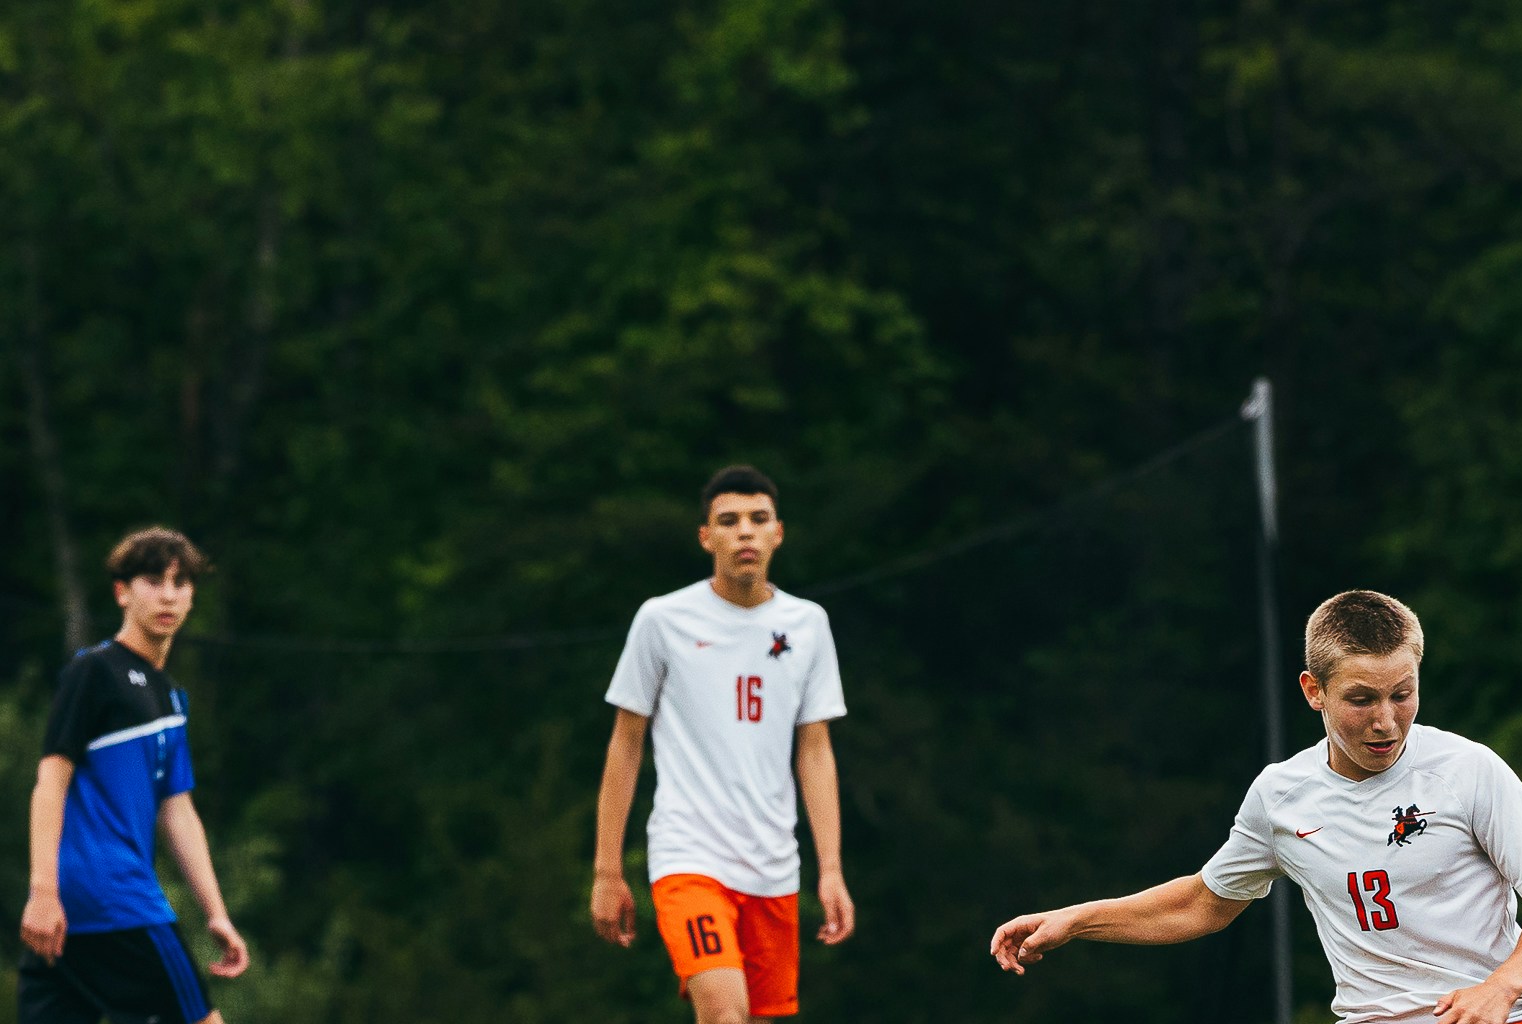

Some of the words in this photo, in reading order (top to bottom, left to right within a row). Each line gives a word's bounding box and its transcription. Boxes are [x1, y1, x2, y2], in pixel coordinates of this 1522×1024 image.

[736, 674, 763, 723] 16
[1346, 868, 1400, 932] 13
[686, 914, 722, 958] 16
